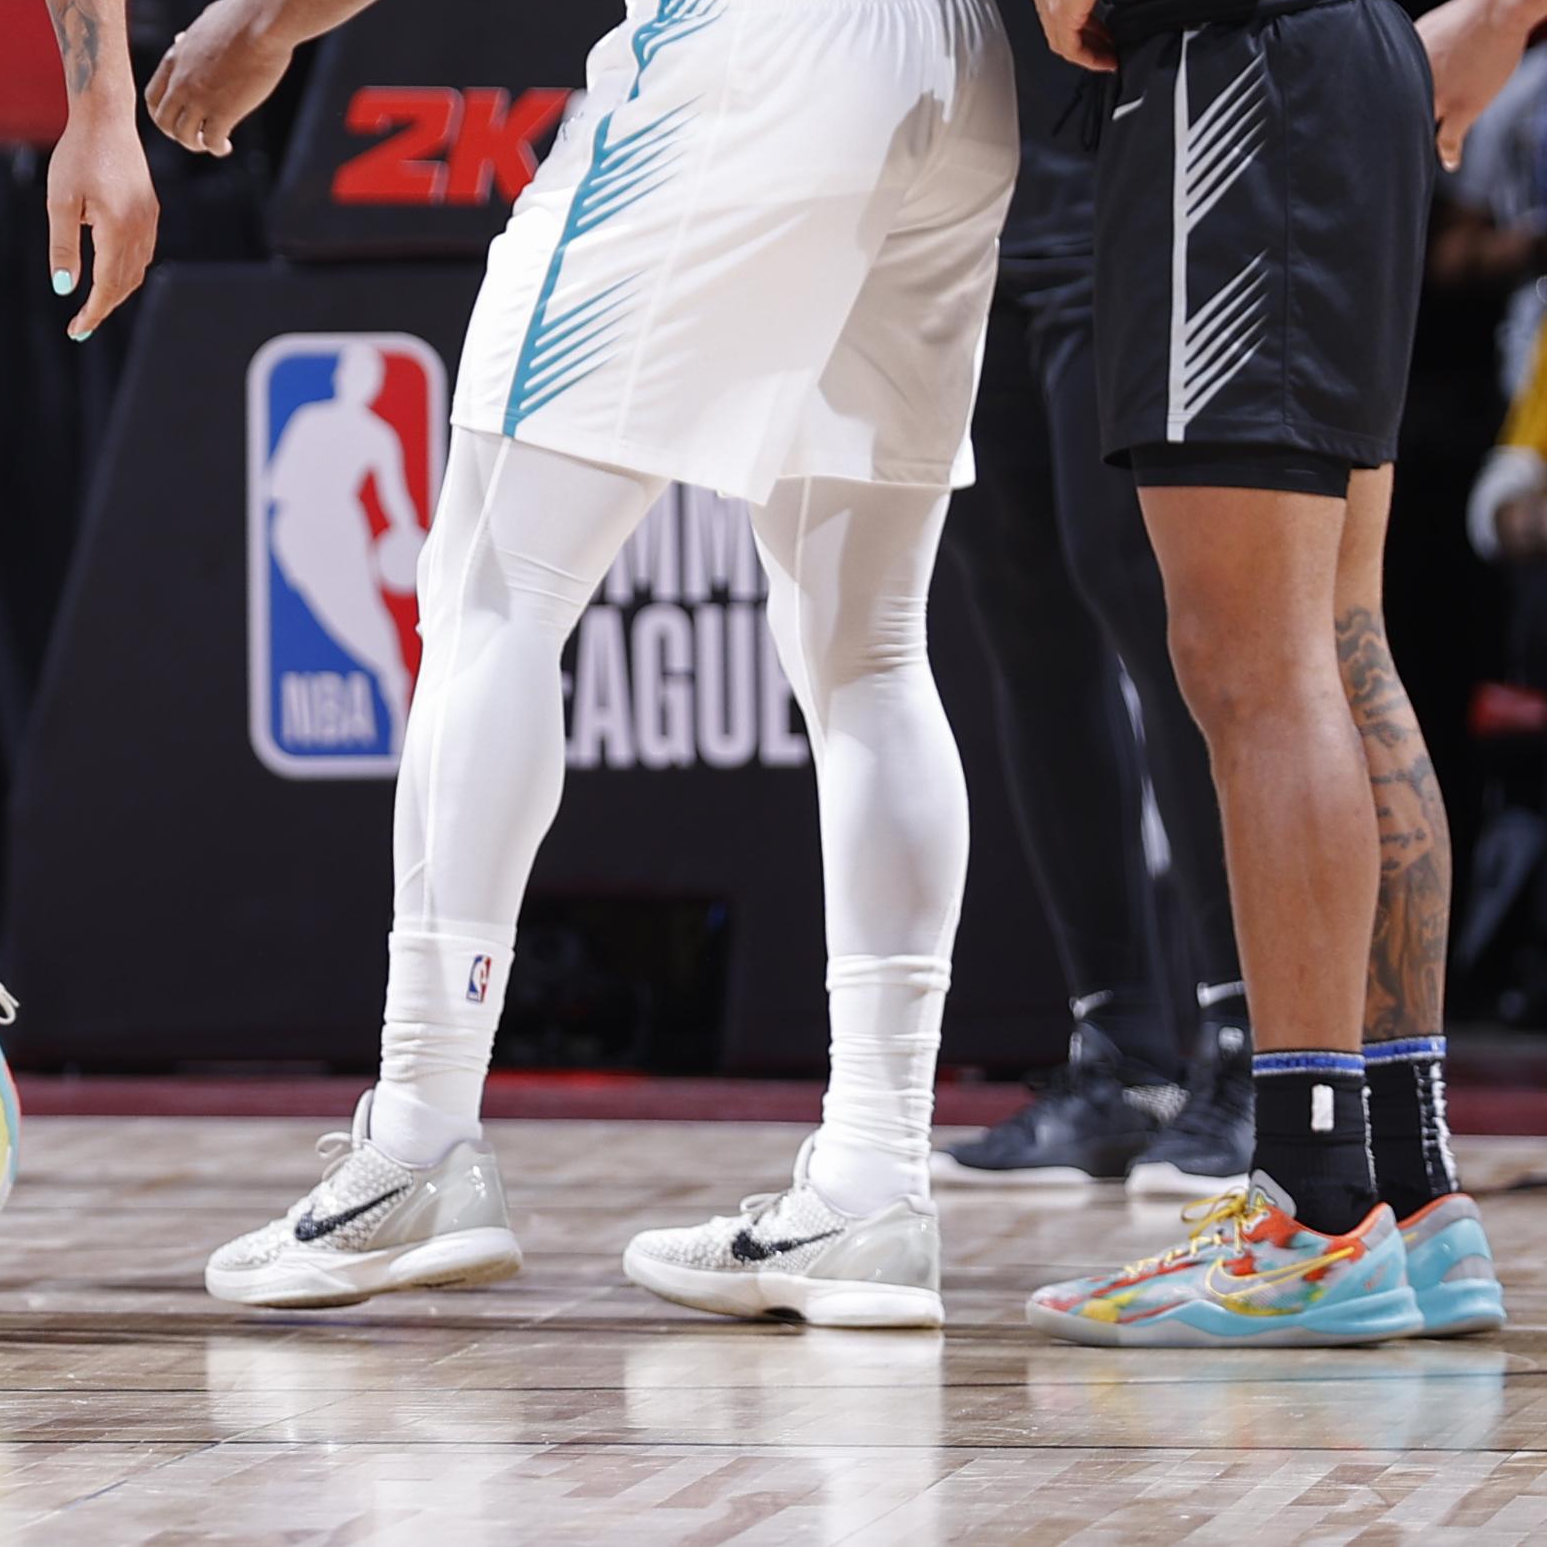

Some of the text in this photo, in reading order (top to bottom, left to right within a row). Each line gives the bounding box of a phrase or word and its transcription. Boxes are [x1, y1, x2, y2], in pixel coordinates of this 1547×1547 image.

[331, 85, 574, 206] 2K
[281, 669, 378, 748] NBA
[562, 602, 811, 770] AGUE
